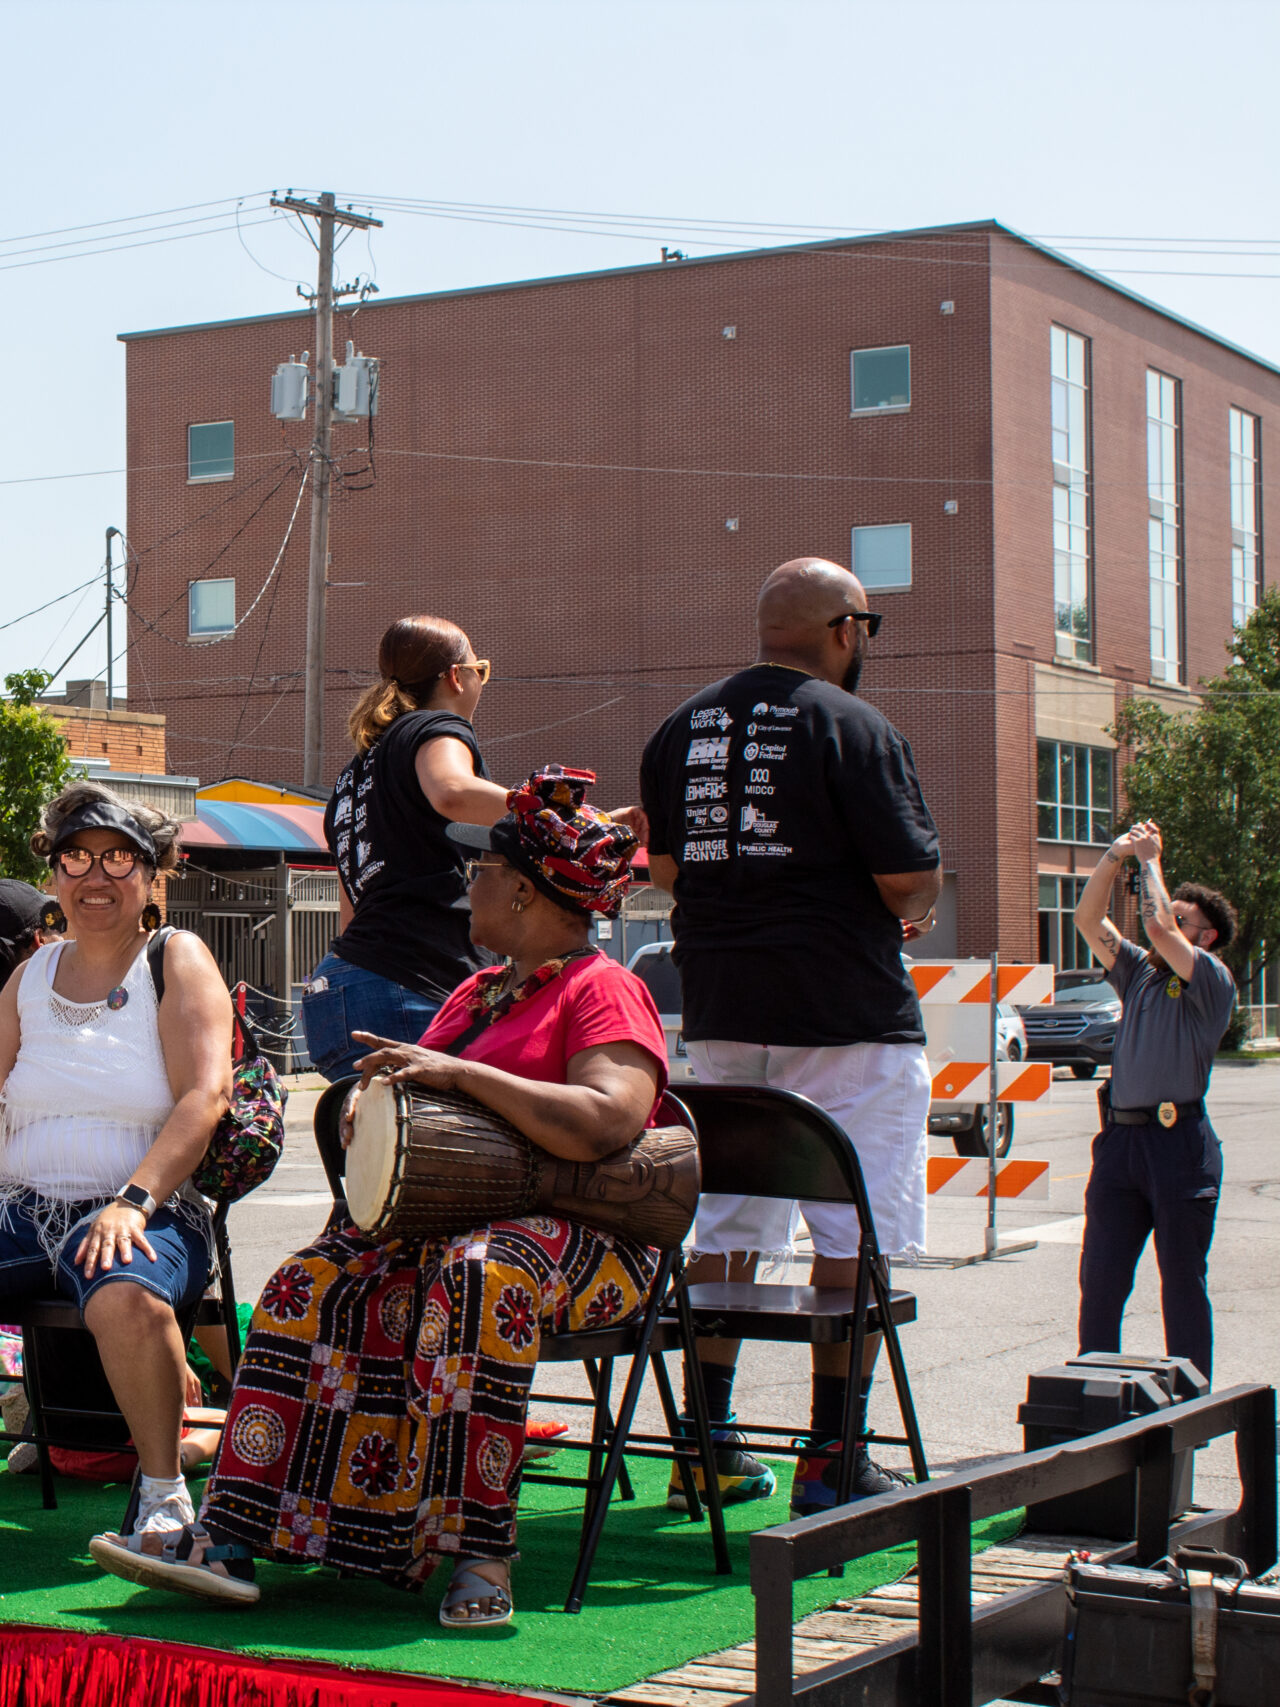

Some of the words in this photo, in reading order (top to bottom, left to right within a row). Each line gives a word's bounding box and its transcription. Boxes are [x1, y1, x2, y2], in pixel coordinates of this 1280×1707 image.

[691, 706, 726, 720] Legacy
[690, 717, 717, 730] Work
[760, 743, 787, 753] Capitol
[758, 751, 786, 761] Federal
[744, 785, 775, 796] MIDCO
[690, 838, 728, 852] BURGER
[767, 845, 793, 854] HEALTH
